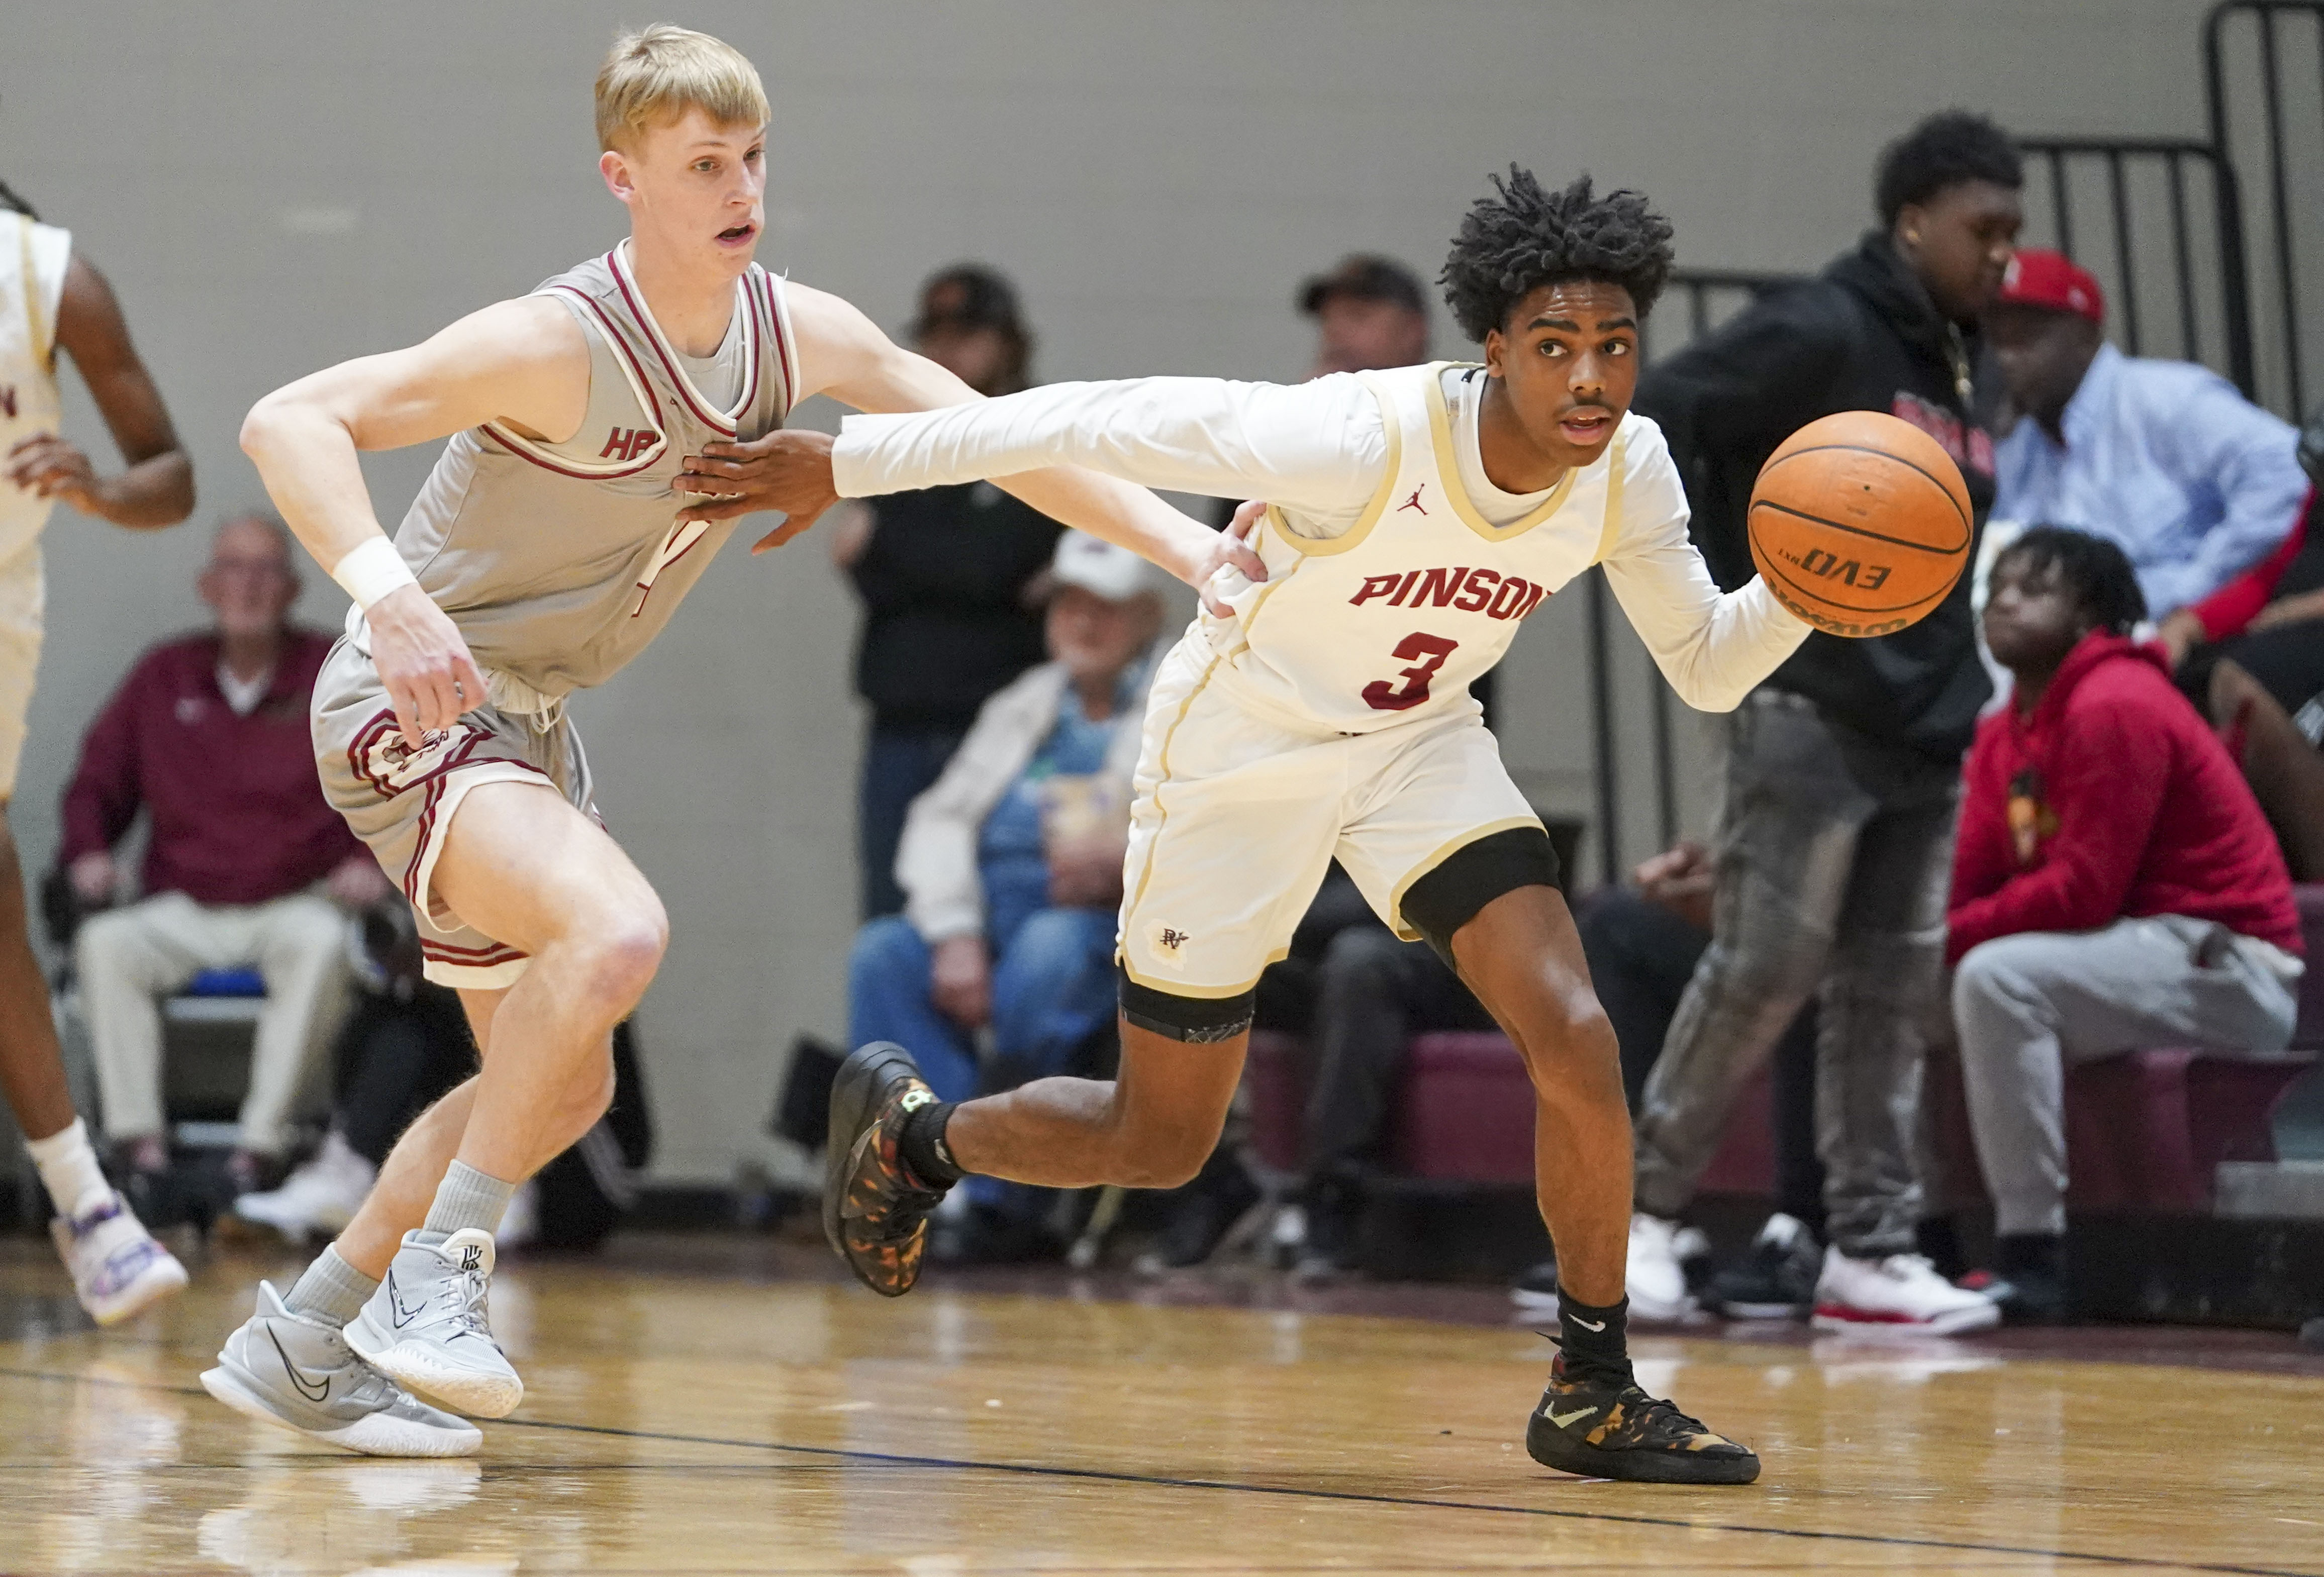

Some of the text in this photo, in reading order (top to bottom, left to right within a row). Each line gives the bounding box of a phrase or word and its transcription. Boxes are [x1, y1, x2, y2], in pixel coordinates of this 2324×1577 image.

[1348, 567, 1553, 621] PINSON
[1801, 548, 1891, 589] EVO
[1362, 631, 1459, 711] 3
